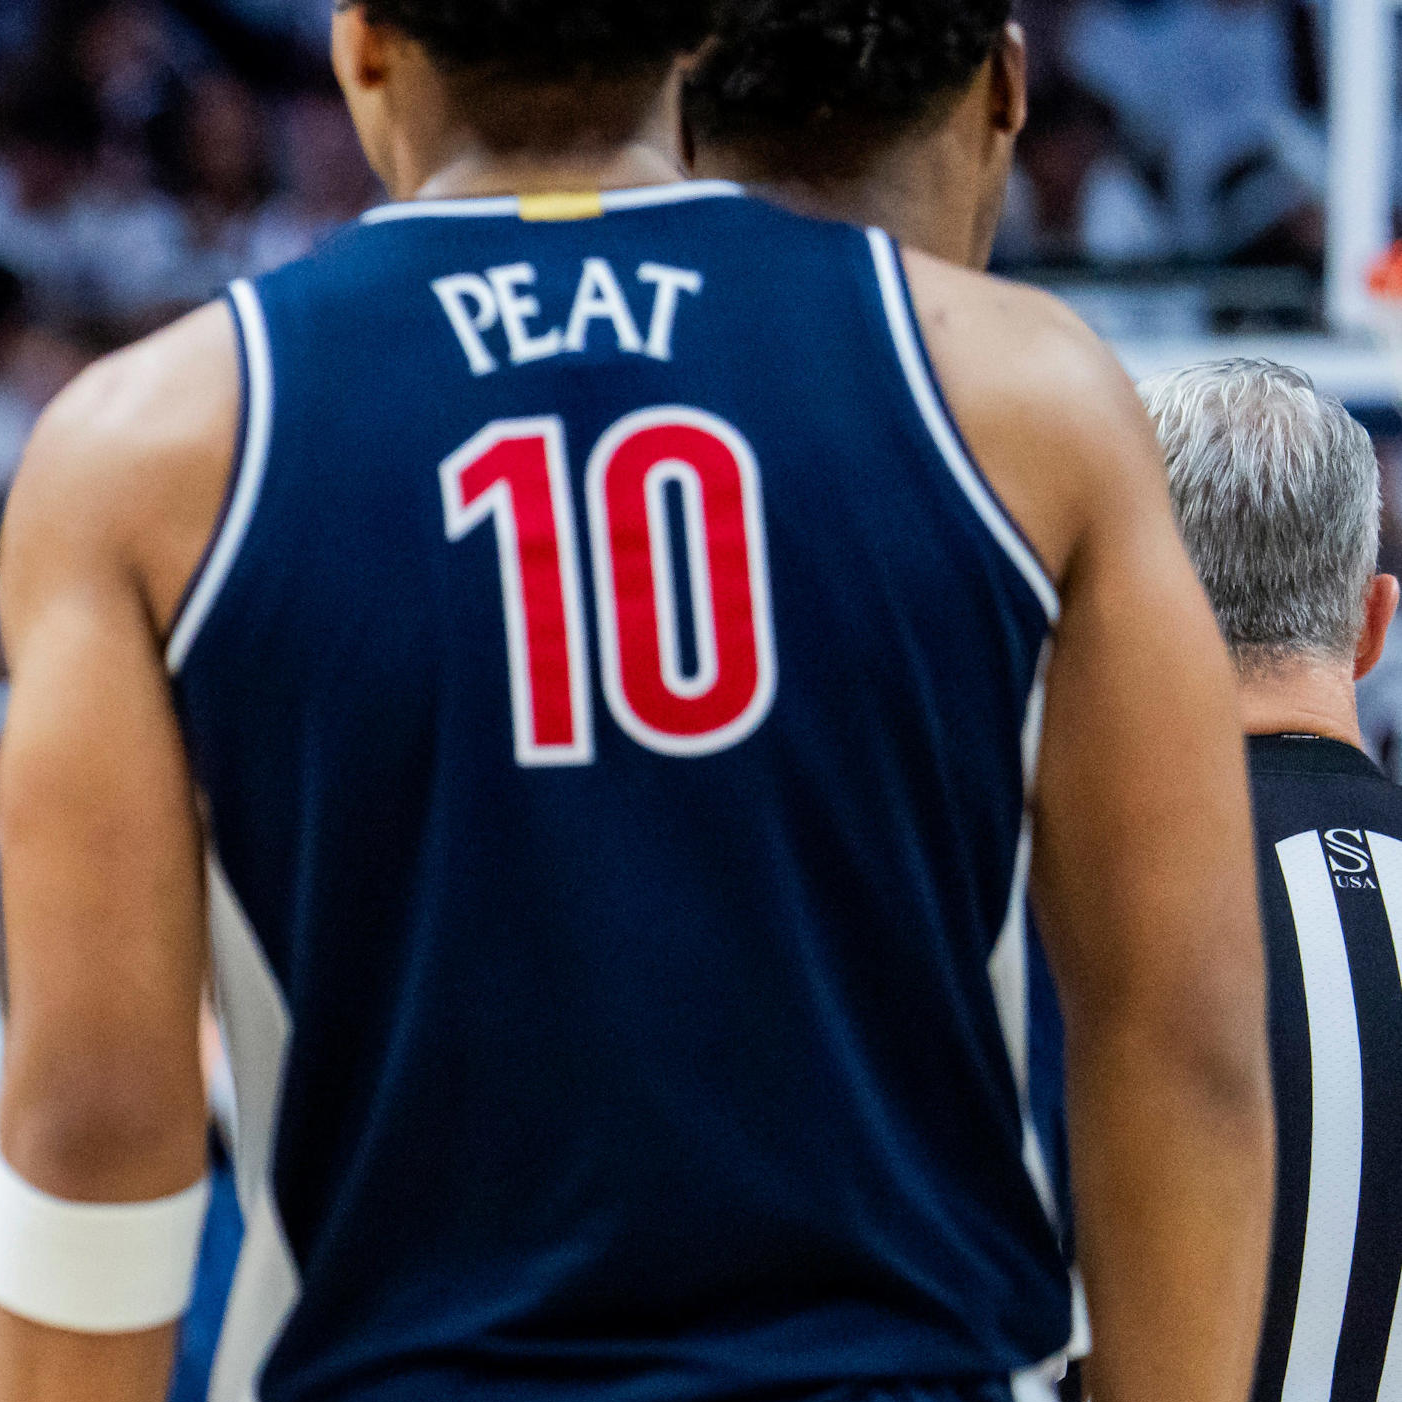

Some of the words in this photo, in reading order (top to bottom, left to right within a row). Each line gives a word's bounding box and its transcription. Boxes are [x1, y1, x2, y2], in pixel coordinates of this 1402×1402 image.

[431, 257, 703, 376] PEAT
[438, 404, 778, 768] 10
[1324, 828, 1371, 873] S
[1334, 875, 1376, 889] USA
